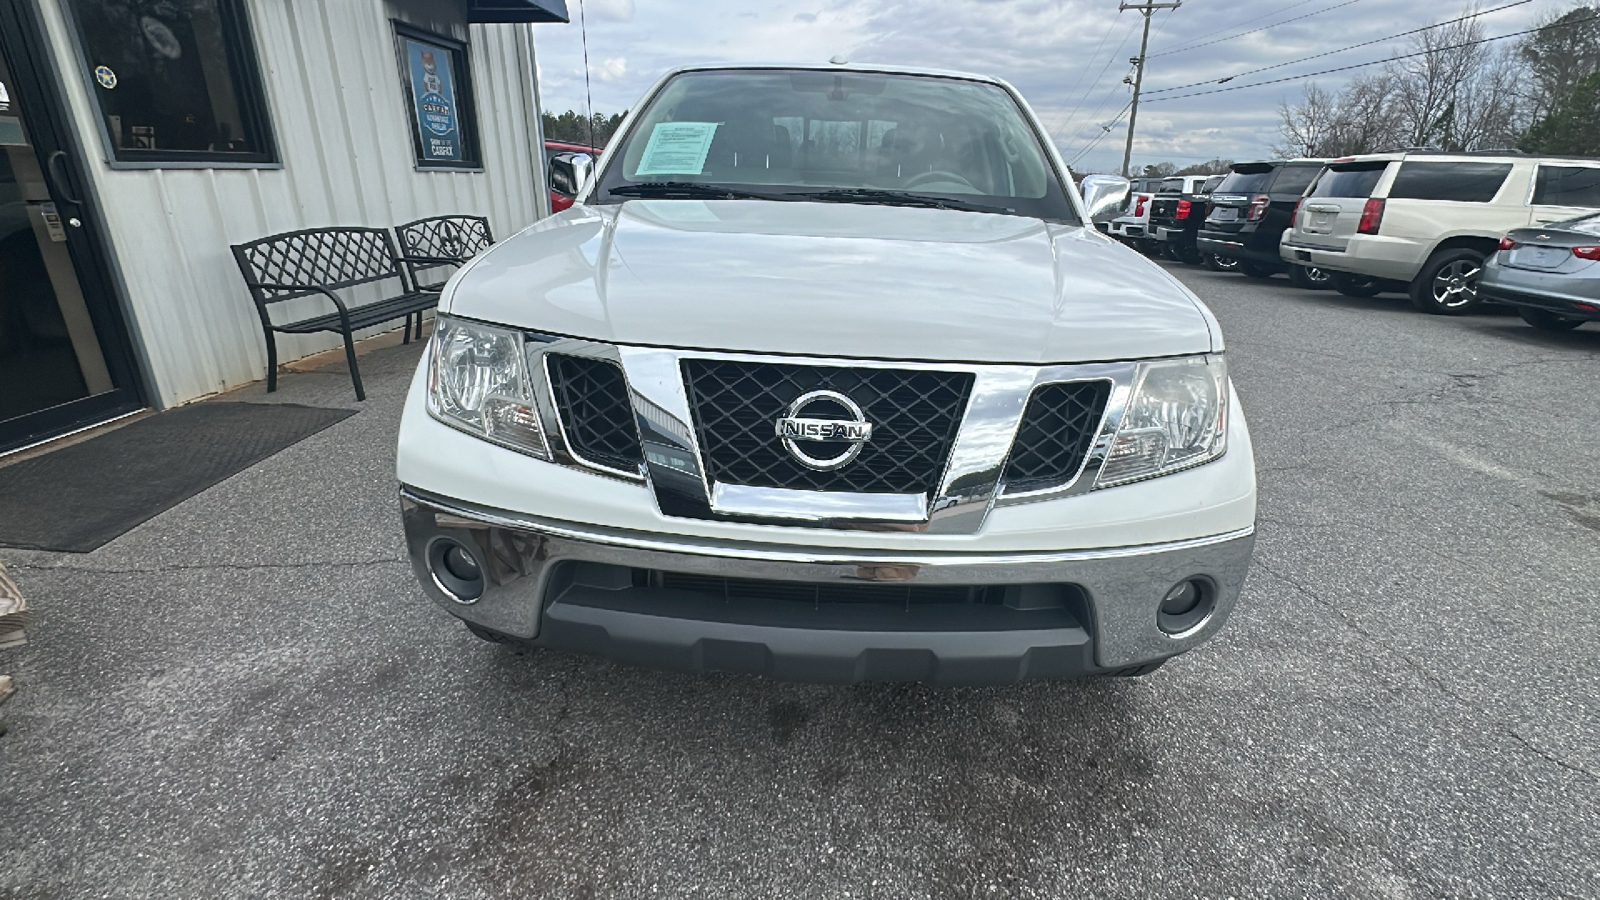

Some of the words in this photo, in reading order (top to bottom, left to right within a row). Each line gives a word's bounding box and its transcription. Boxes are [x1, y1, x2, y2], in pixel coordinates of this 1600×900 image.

[423, 103, 449, 115] CARFAX
[432, 145, 454, 156] CARFAX
[784, 421, 862, 437] NISSAN
